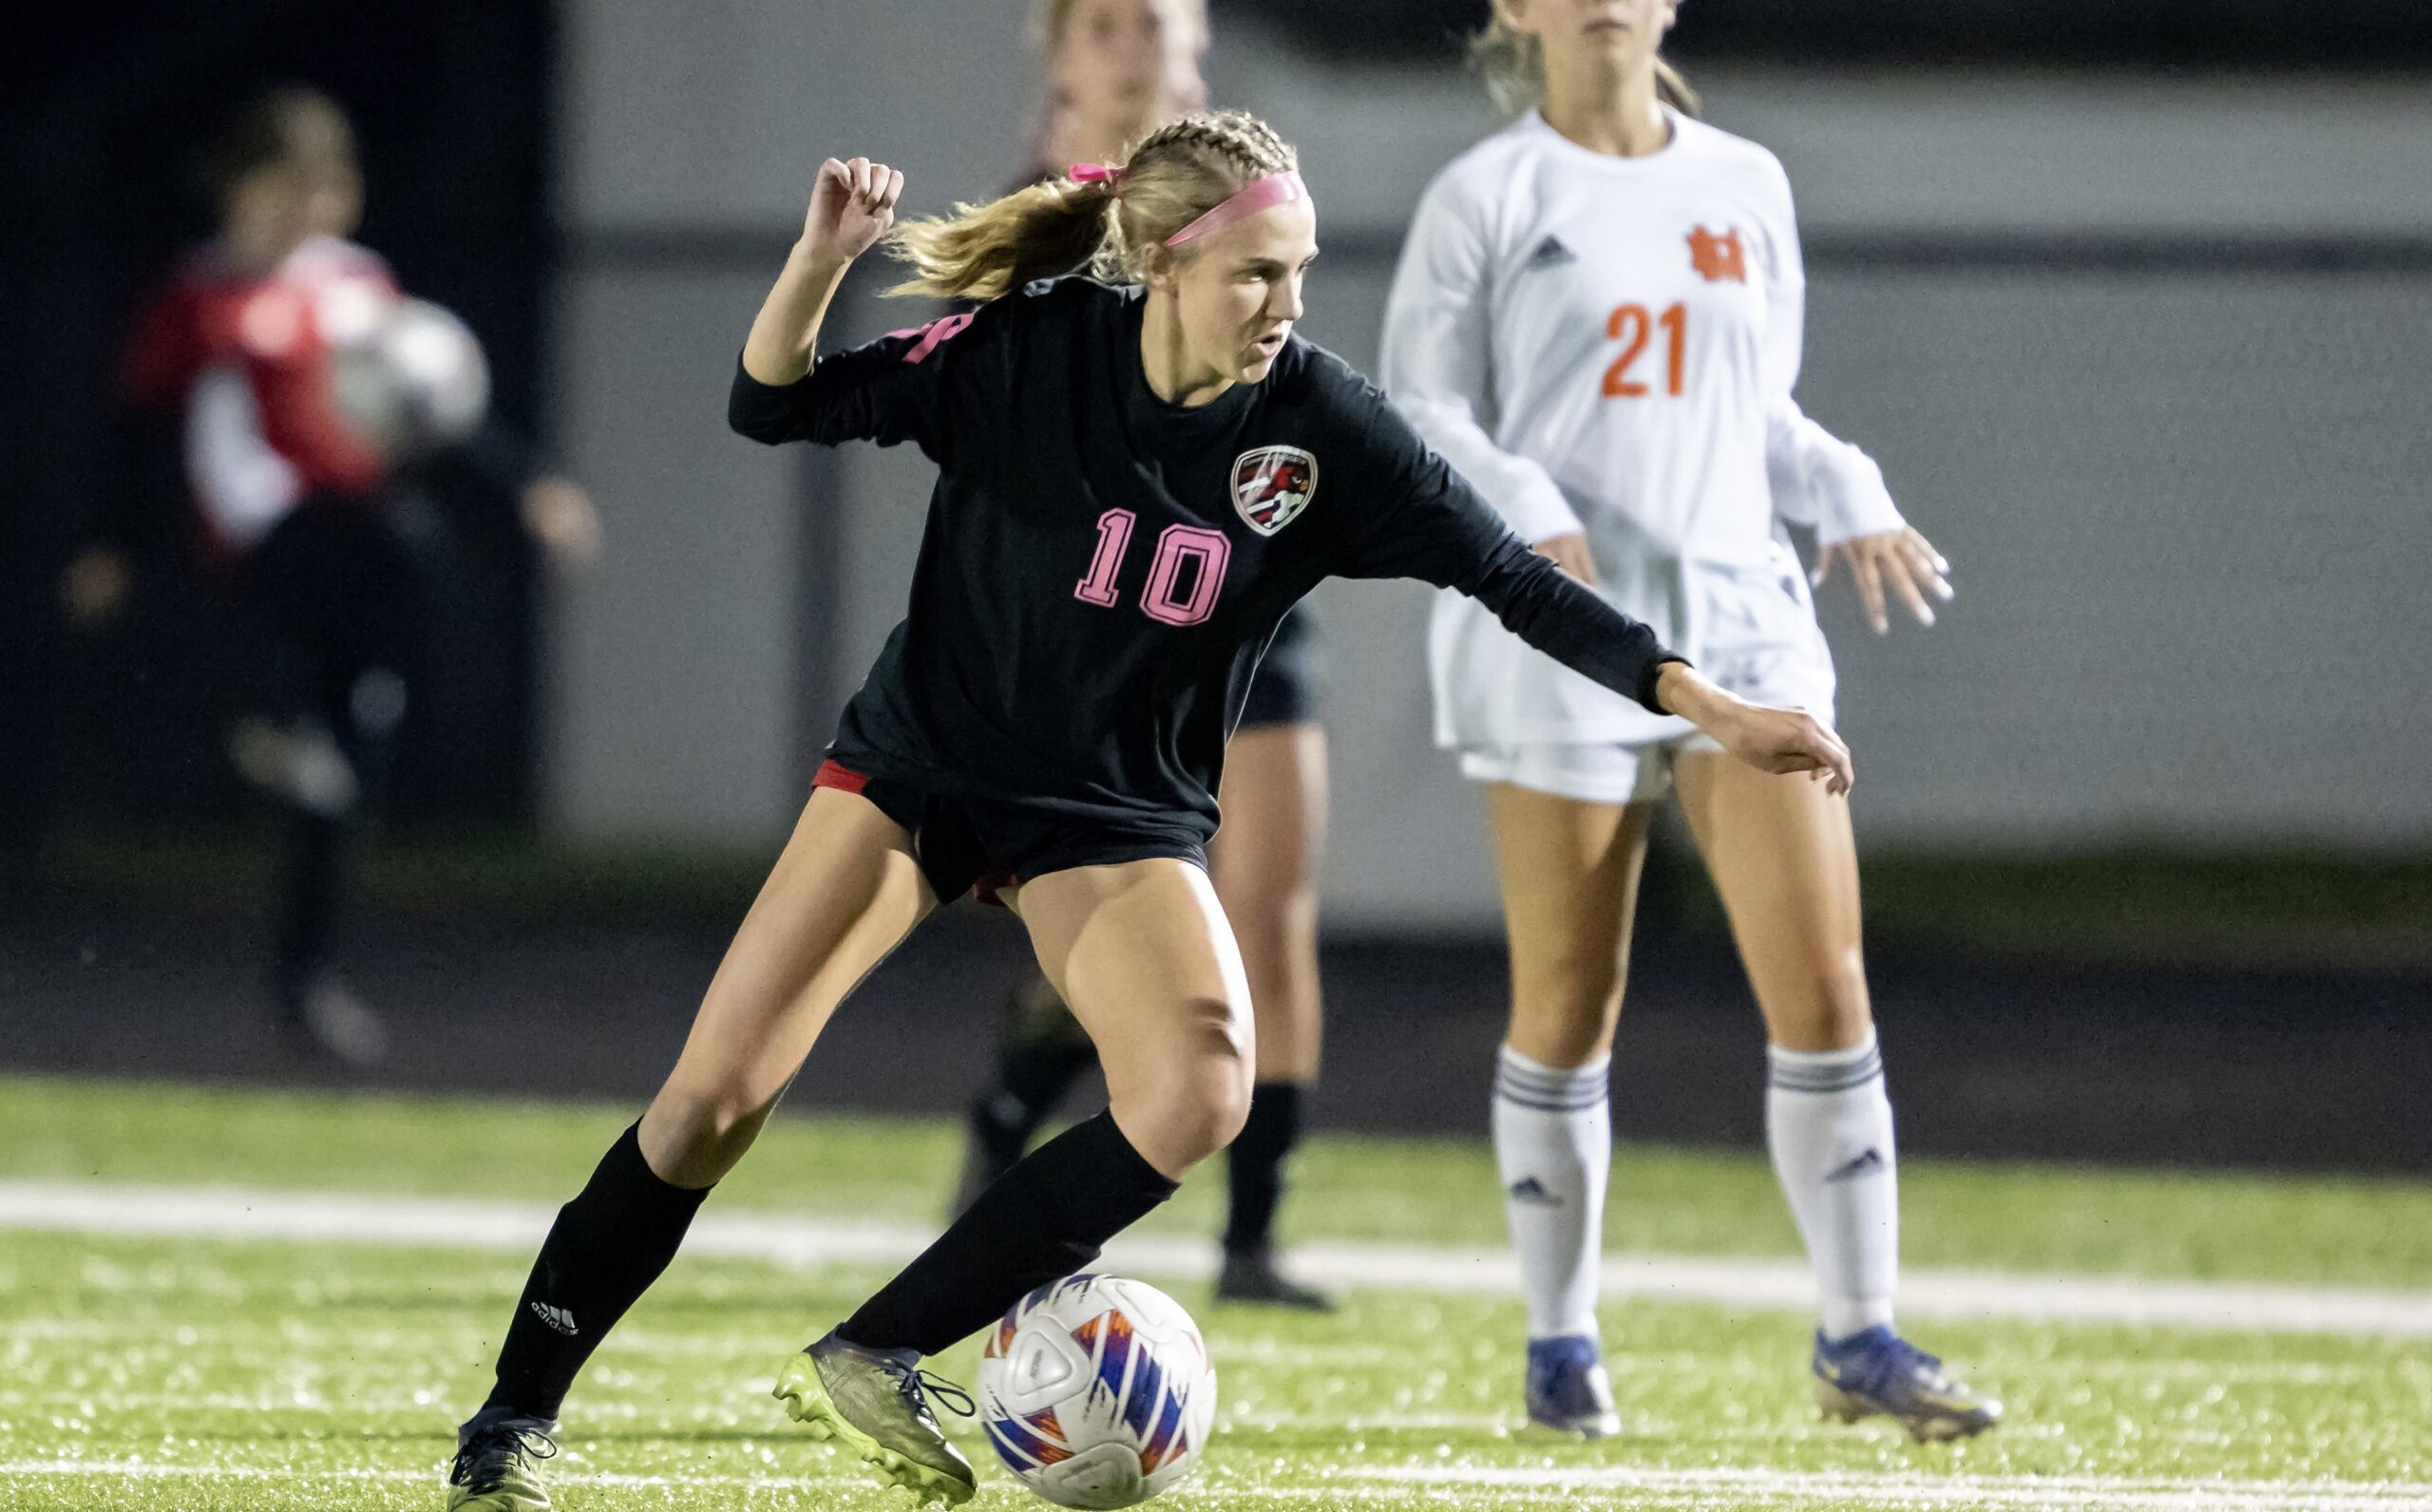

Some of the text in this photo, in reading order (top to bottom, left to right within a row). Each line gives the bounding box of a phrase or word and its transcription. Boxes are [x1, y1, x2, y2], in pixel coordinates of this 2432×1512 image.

[1601, 301, 1686, 398] 21
[1074, 507, 1231, 627] 10
[531, 1301, 580, 1335] adidas
